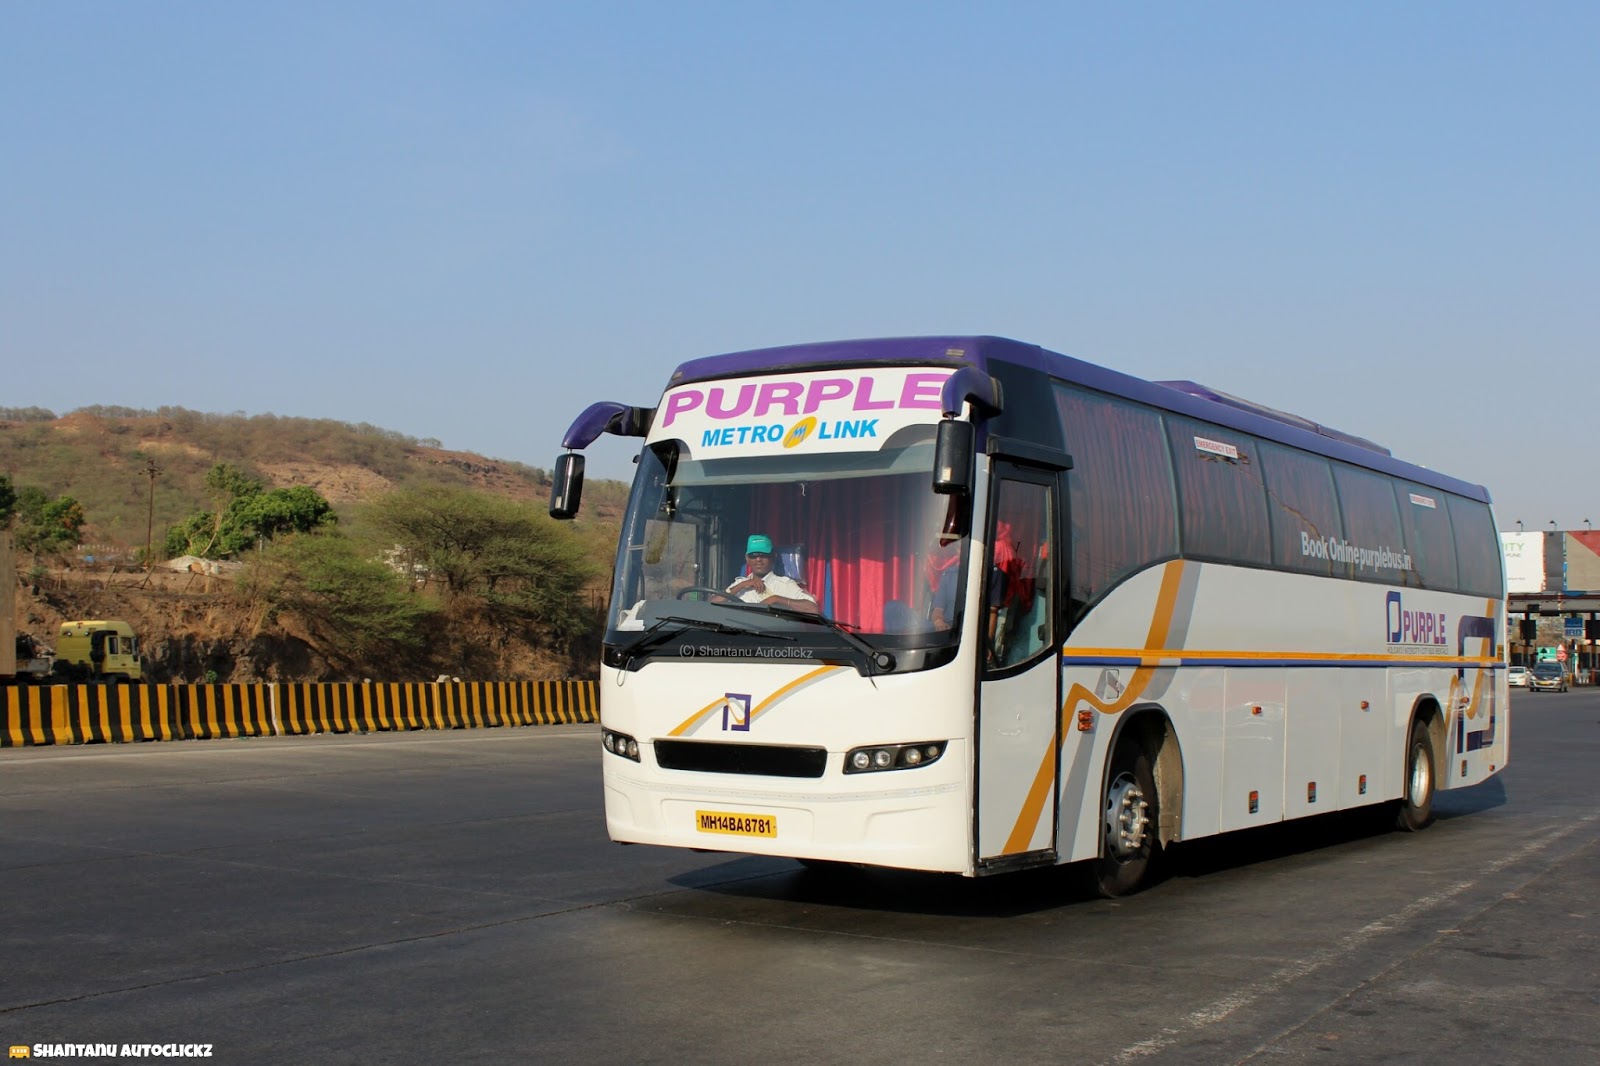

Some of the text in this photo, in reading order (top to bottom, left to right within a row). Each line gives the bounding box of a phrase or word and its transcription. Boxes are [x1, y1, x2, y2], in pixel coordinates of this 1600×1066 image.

[662, 373, 951, 428] PURPLE
[701, 419, 879, 447] METRO LINK
[1301, 531, 1329, 559] Book
[1403, 610, 1446, 645] PURPLE
[701, 815, 771, 834] MH14BA8781
